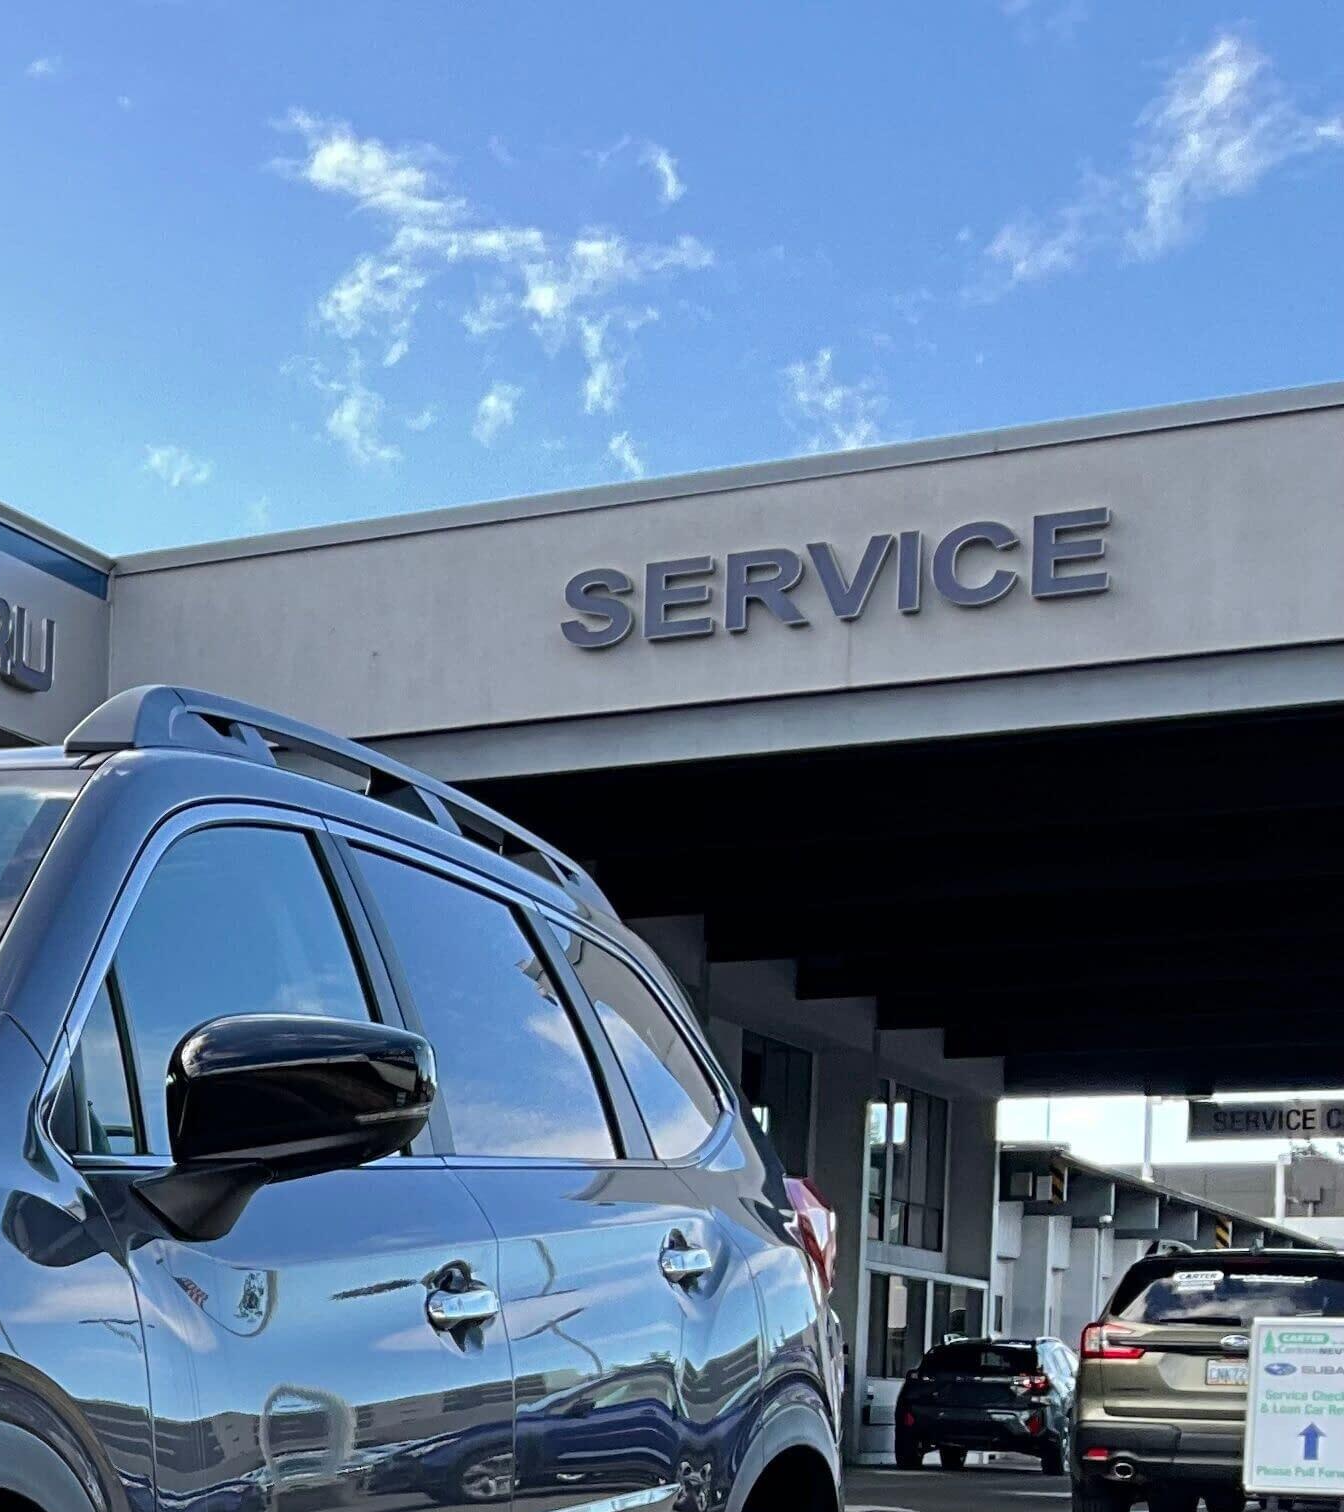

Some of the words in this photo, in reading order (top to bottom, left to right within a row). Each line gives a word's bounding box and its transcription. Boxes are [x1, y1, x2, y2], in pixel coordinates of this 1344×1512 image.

[560, 507, 1111, 648] SERVICE
[1213, 1108, 1317, 1132] SERVICE
[1178, 1272, 1218, 1280] CARTER
[1265, 1389, 1308, 1400] Service
[1305, 1404, 1323, 1414] Car
